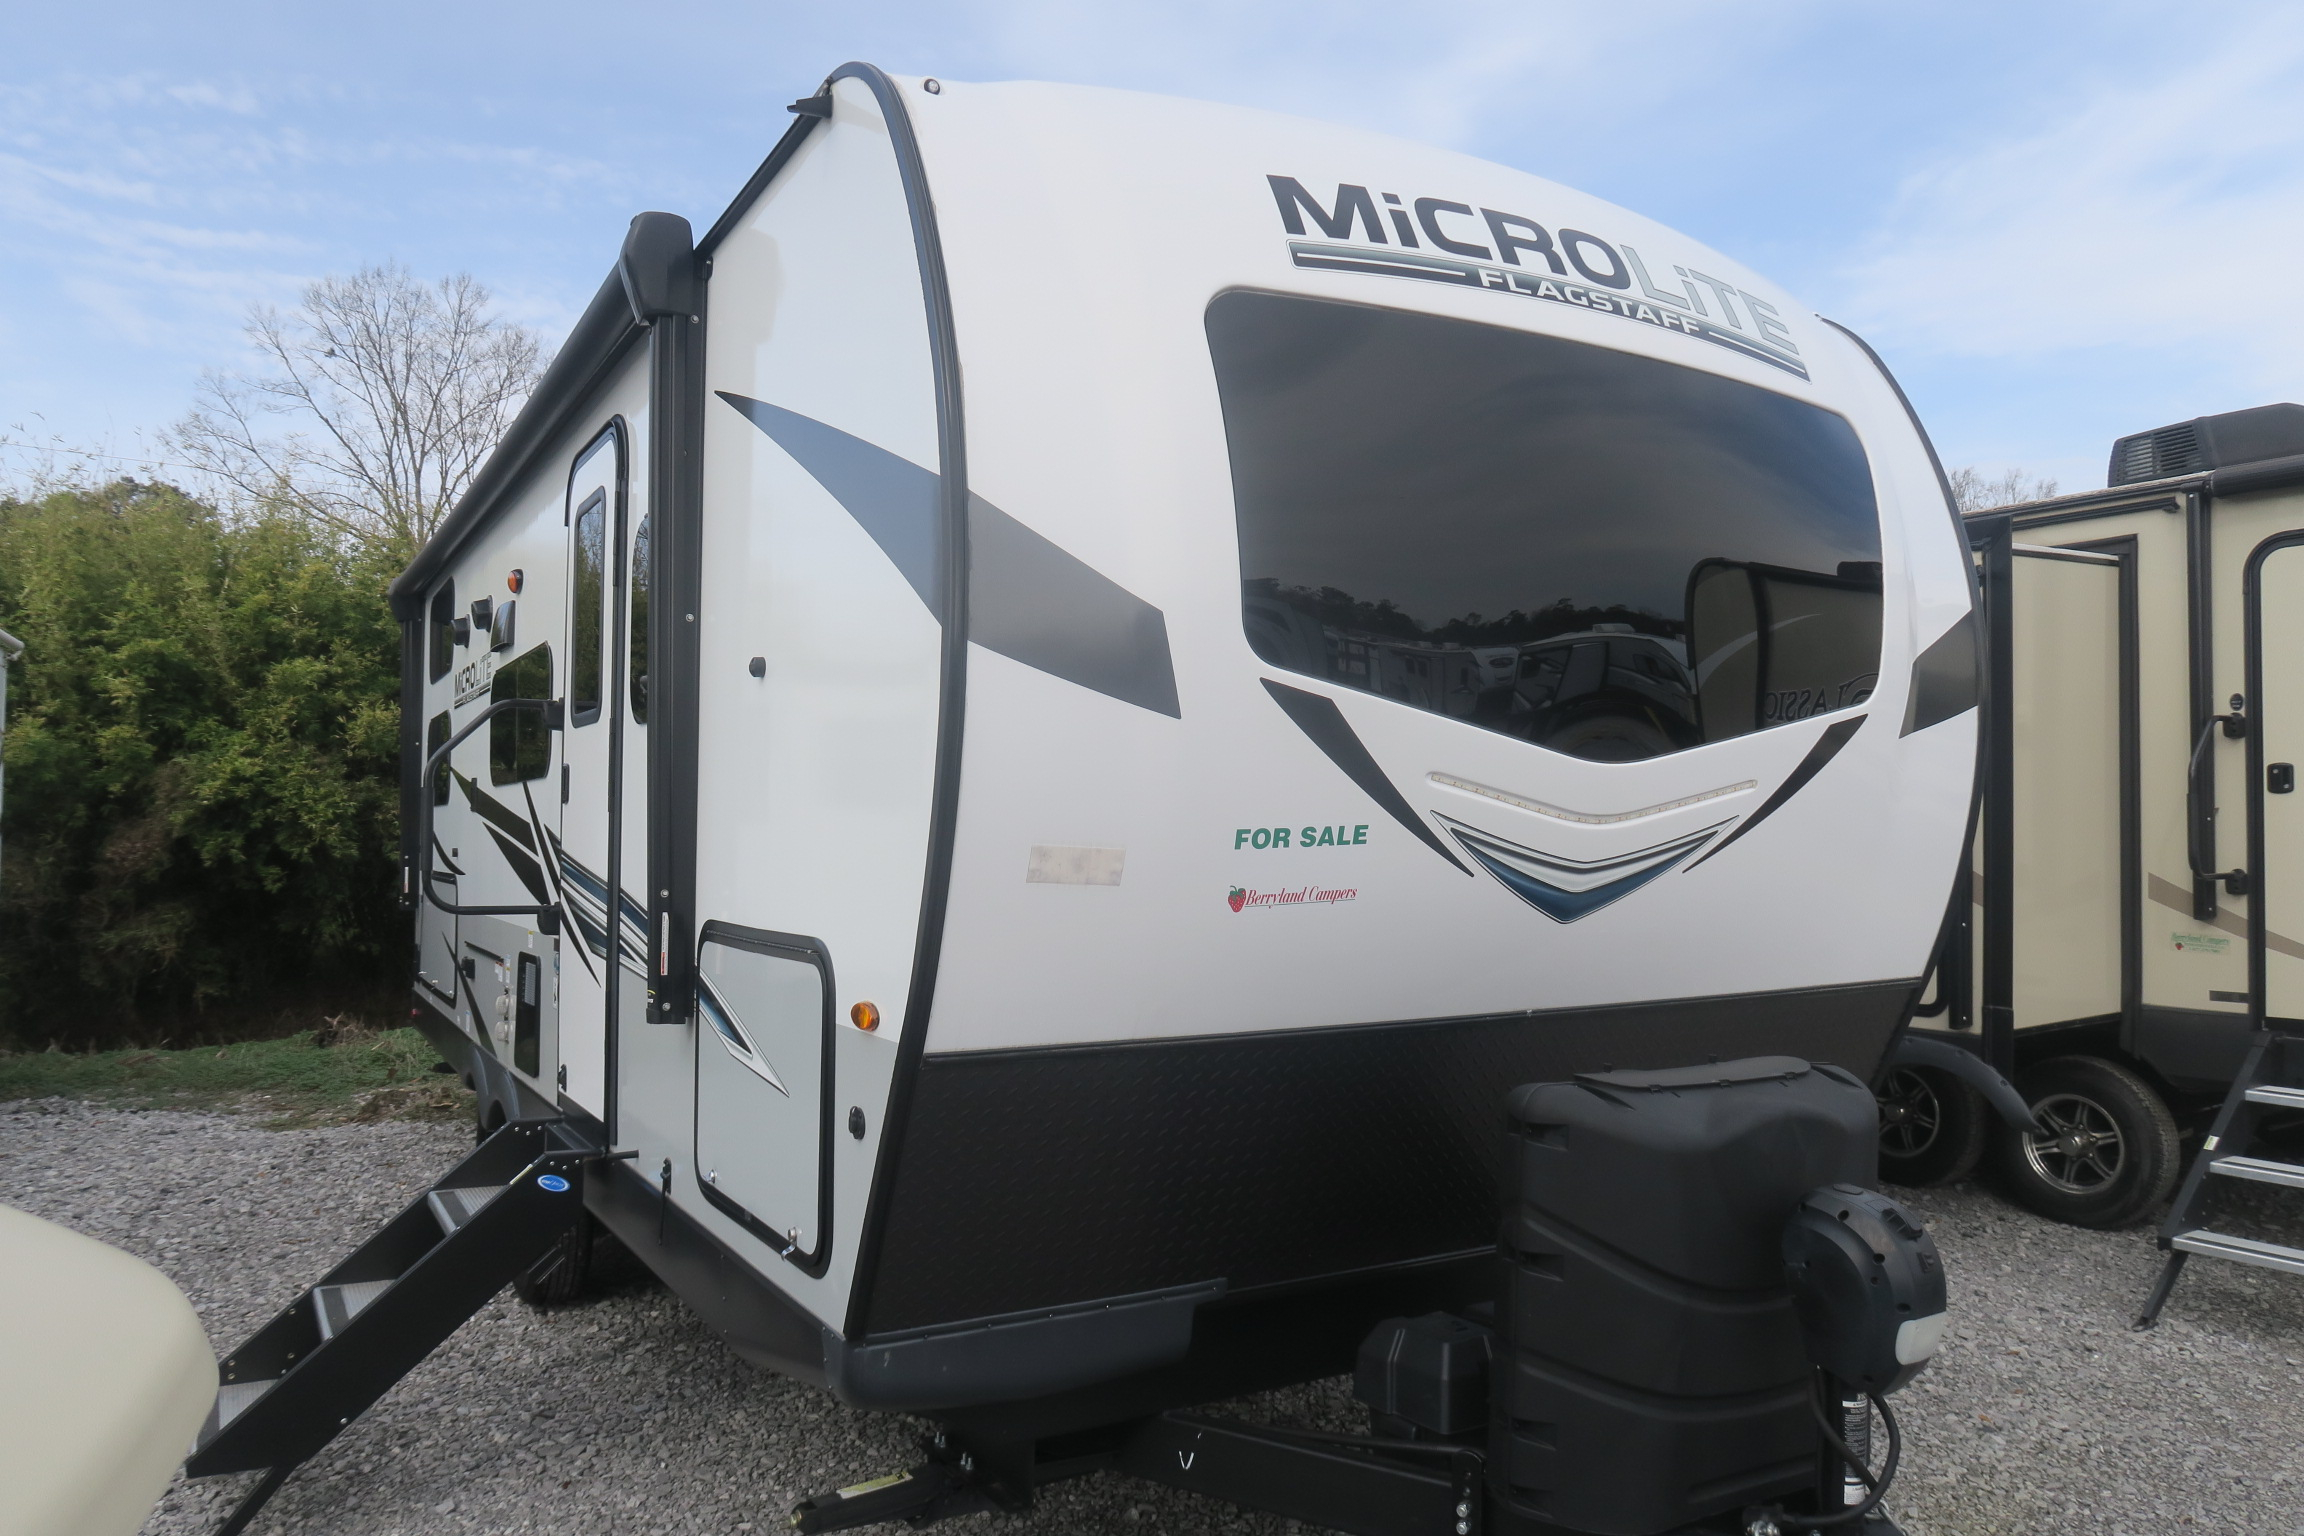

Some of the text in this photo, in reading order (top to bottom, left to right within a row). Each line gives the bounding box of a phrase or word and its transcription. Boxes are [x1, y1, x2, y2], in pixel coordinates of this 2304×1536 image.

[1477, 268, 1700, 334] FLAGSTAFF
[1234, 824, 1369, 850] FOR SALE
[1245, 885, 1358, 909] Berryland Campers
